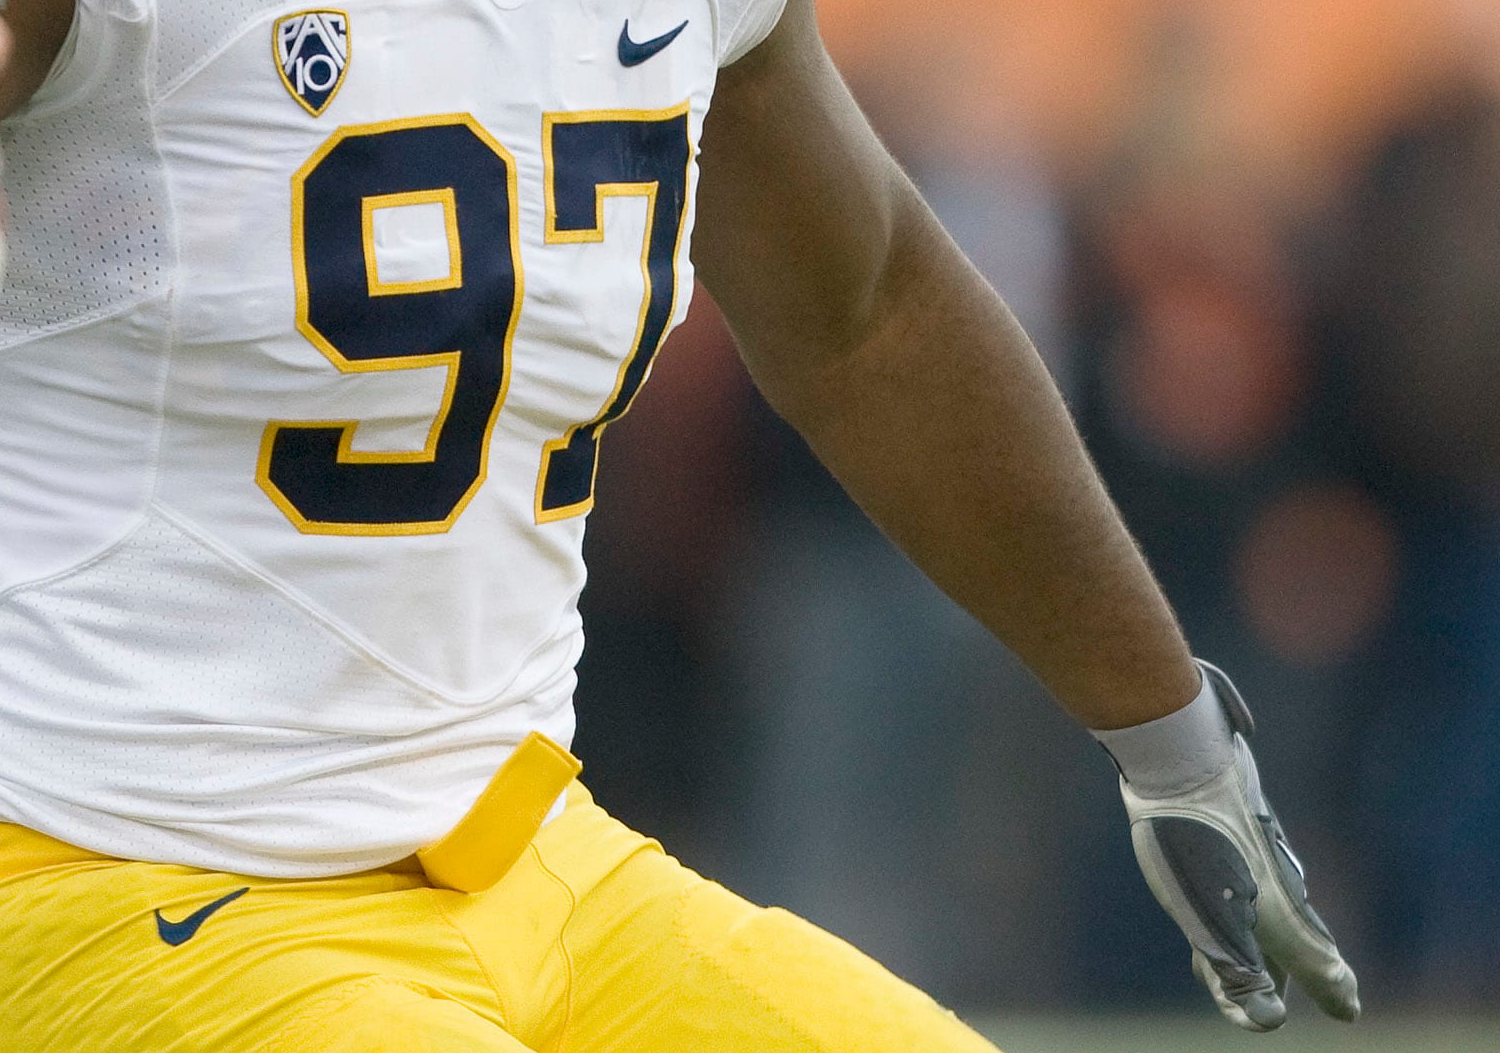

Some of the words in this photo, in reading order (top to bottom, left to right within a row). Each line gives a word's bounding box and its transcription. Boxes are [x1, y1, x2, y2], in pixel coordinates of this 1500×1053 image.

[278, 13, 346, 75] PAC
[296, 54, 338, 95] 10
[255, 99, 694, 535] 97
